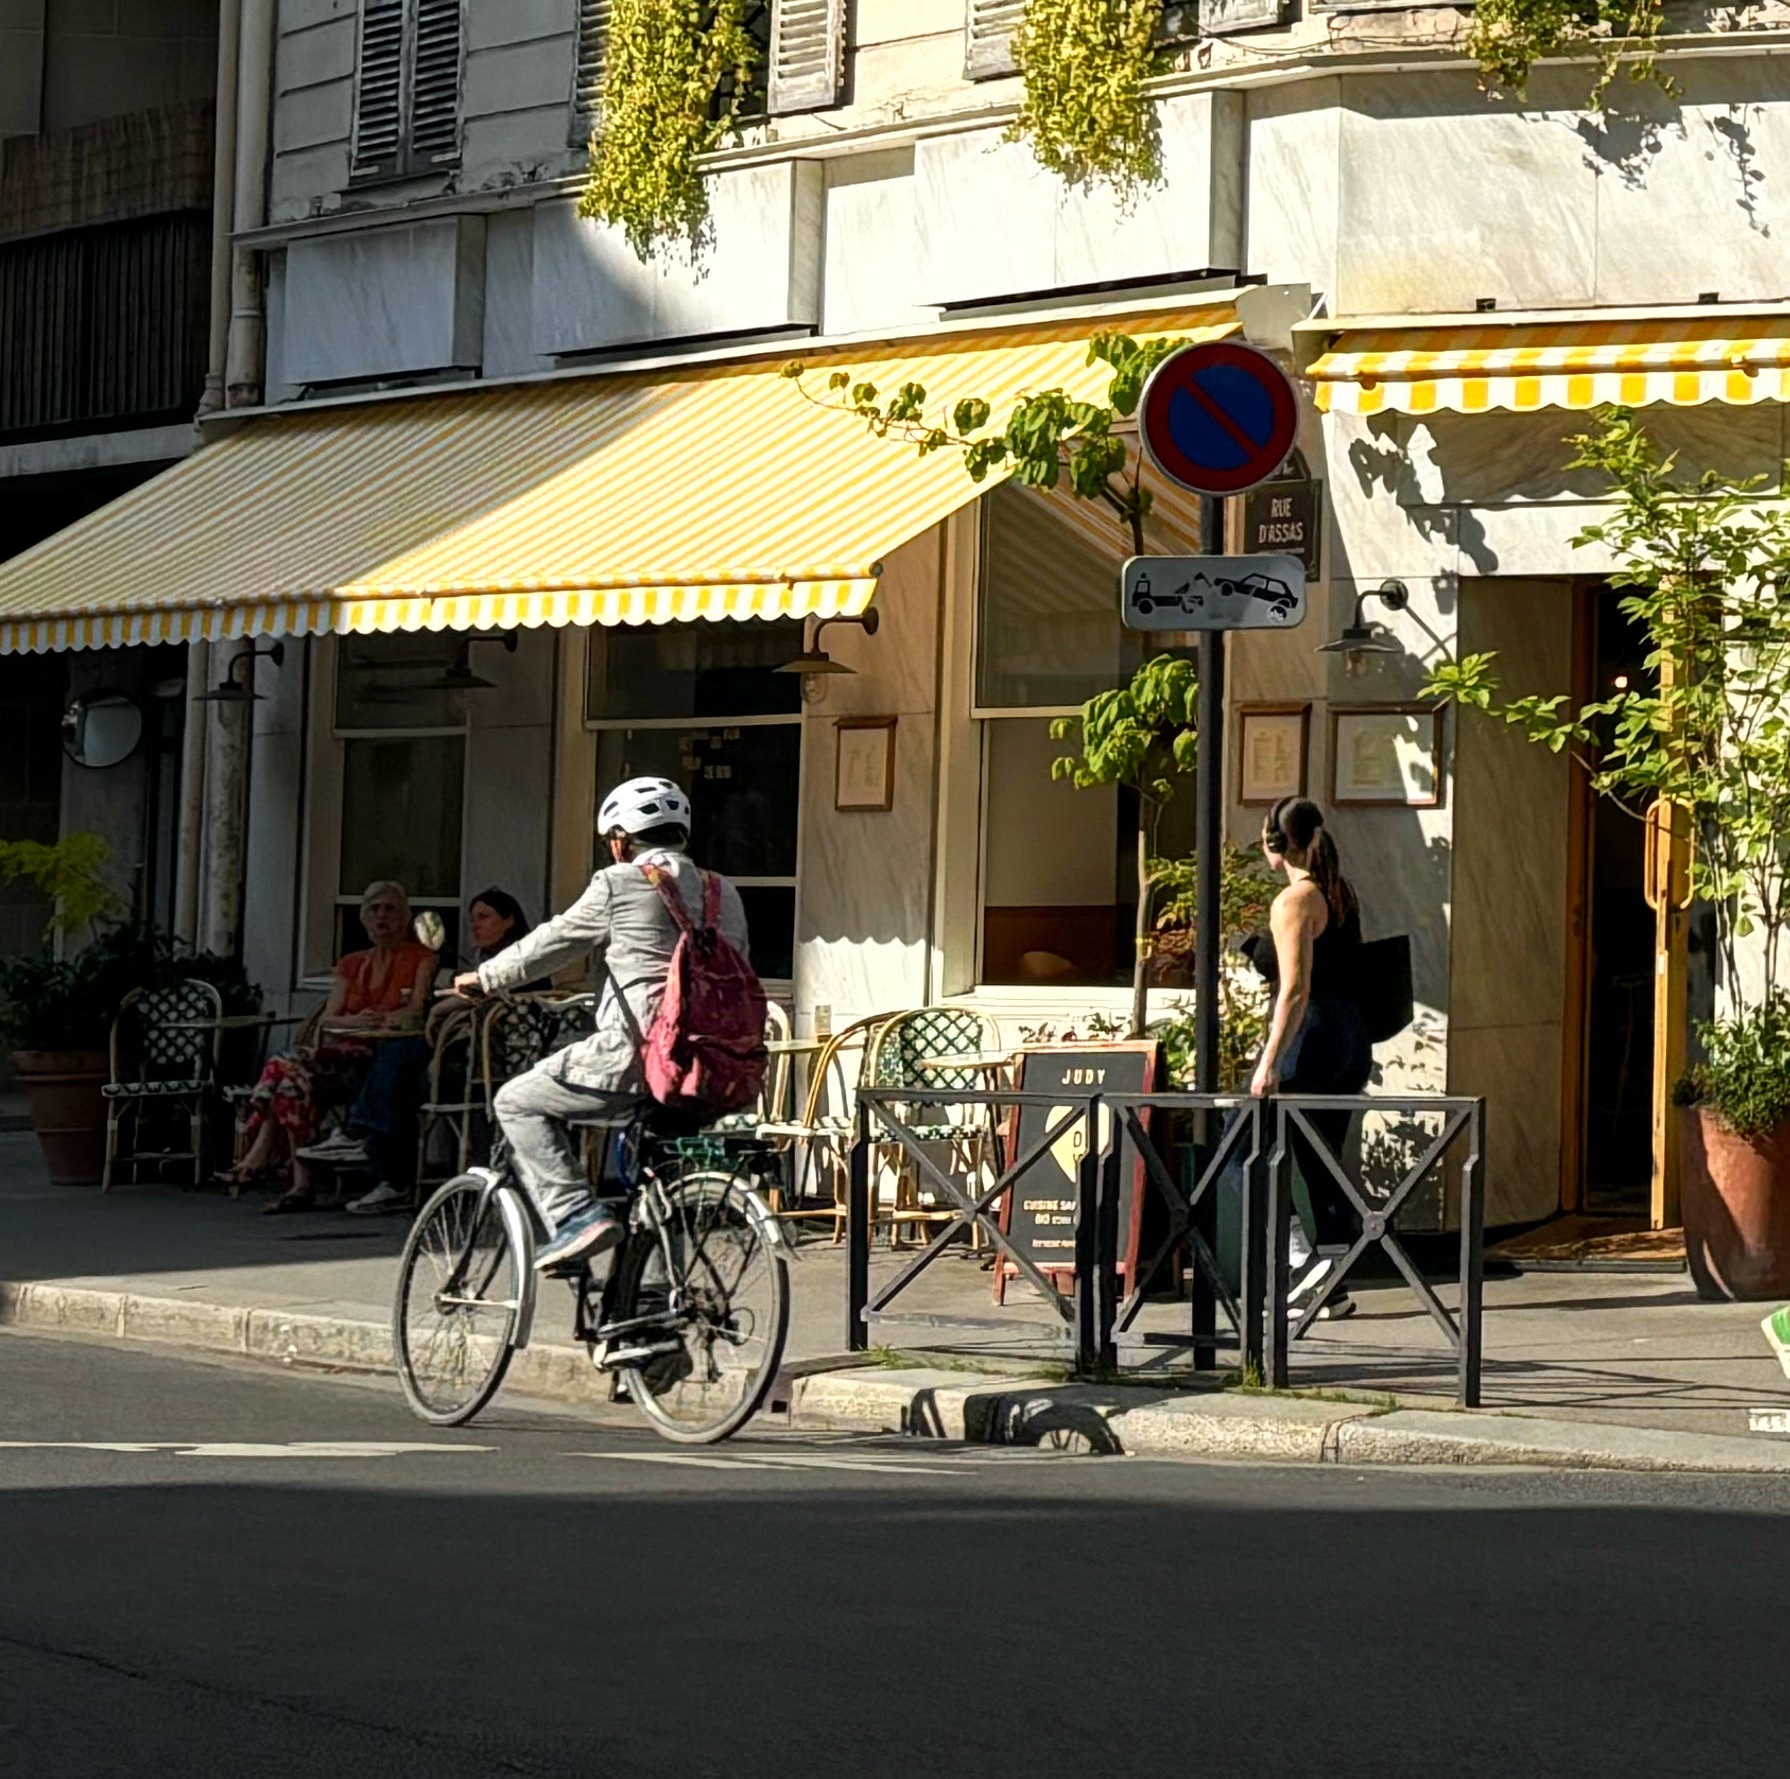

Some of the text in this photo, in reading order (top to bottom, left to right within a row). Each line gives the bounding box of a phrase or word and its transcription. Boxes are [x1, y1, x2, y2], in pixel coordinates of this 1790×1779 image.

[1271, 497, 1293, 518] RUE
[1258, 522, 1304, 544] D'ASSAS
[1061, 1069, 1106, 1085] JUDY
